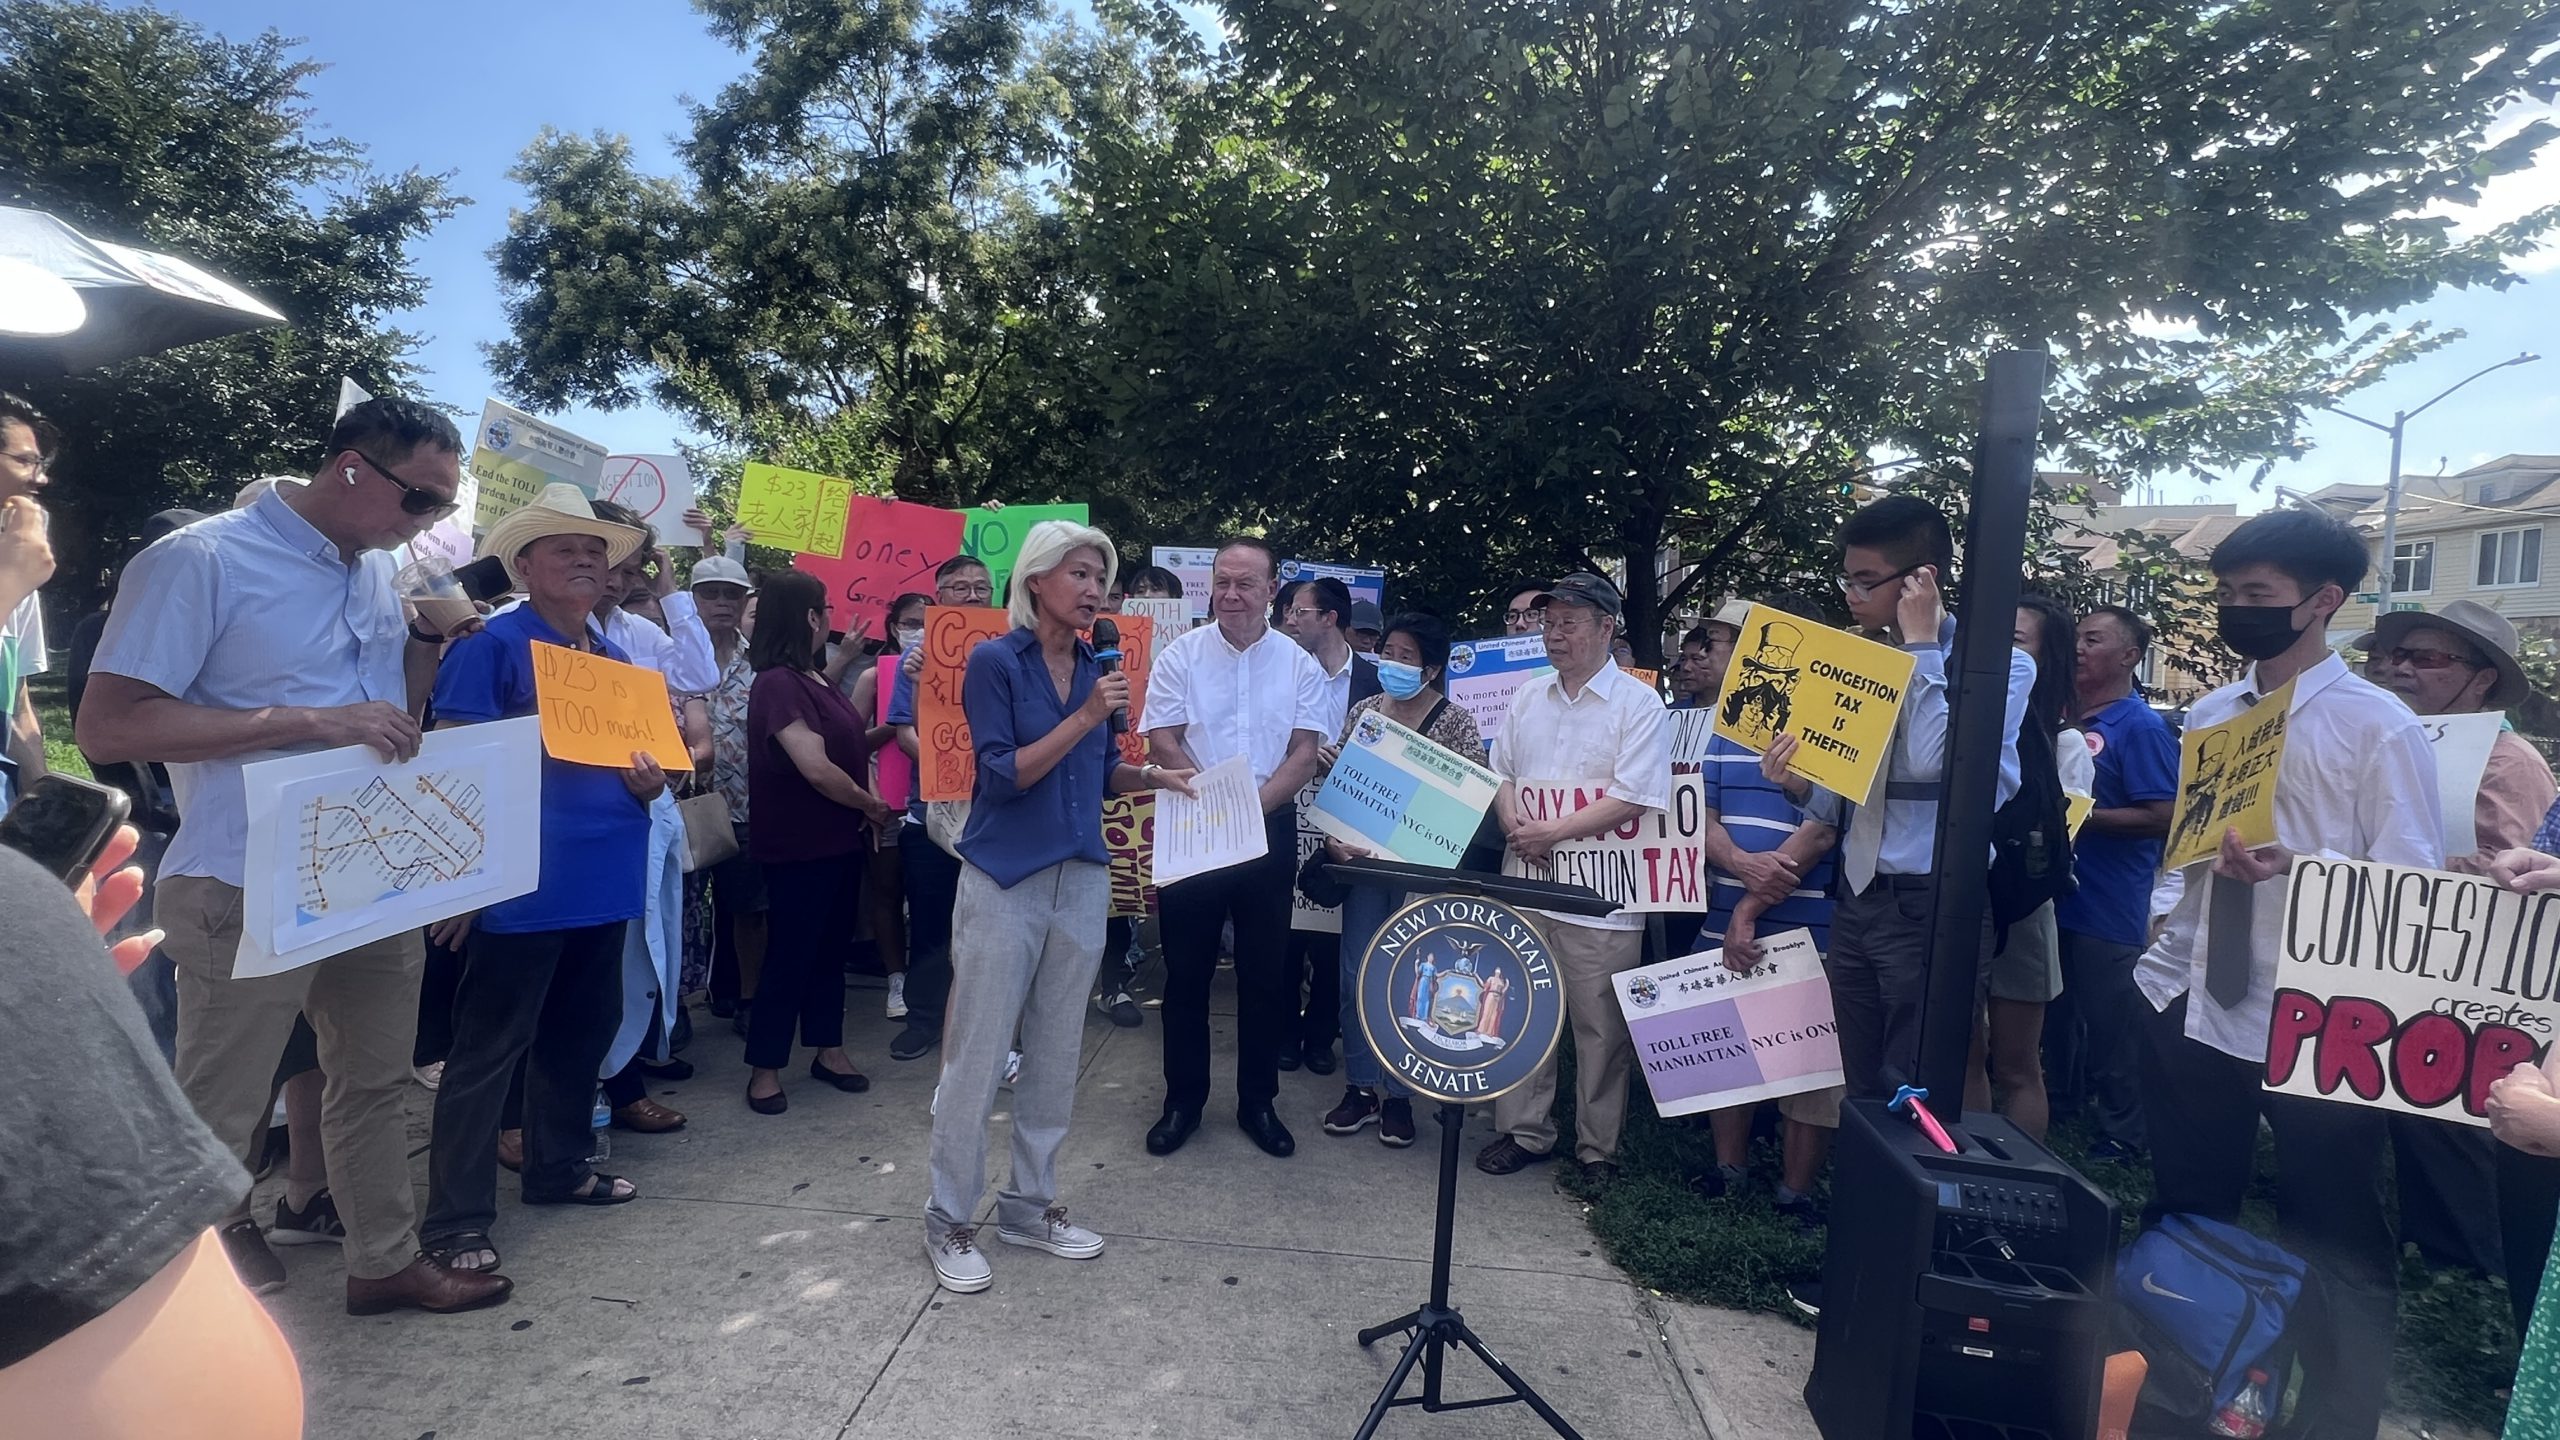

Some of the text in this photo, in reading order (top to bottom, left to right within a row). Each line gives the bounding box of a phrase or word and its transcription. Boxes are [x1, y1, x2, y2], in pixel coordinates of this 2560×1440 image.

[475, 464, 494, 480] End
[496, 471, 510, 486] the
[511, 477, 537, 496] TOLL
[479, 486, 508, 502] urden,
[509, 493, 521, 506] let
[764, 473, 807, 501] $23
[476, 500, 497, 514] ravel
[740, 500, 814, 539] 老人家
[856, 539, 942, 585] oney
[1127, 601, 1182, 621] SOUTH
[538, 644, 597, 692] $23
[1809, 659, 1899, 705] CONGESTION
[1456, 692, 1470, 702] No
[1472, 690, 1498, 700] more
[1834, 692, 1863, 715] TAX
[544, 696, 656, 742] TOO much!
[1481, 716, 1497, 727] all!
[1832, 716, 1846, 732] IS
[1385, 721, 1499, 790] United Chinese Association of Brooklyn
[1801, 726, 1860, 764] THEFT!!!
[1331, 775, 1399, 822] MANHATTAN
[1344, 764, 1371, 788] TOLL
[1371, 781, 1402, 804] FREE
[1521, 786, 1565, 822] SAY
[1399, 814, 1466, 858] NYC is ONE!
[1642, 847, 1699, 903] TAX
[1379, 901, 1553, 991] NEW YORK STATE
[1772, 940, 1806, 954] Brooklyn
[2286, 859, 2560, 1003] CONGESTIO
[1657, 971, 1680, 982] United
[1683, 964, 1709, 975] Chinese
[2431, 996, 2553, 1034] creates
[1647, 1025, 1734, 1055] TOLL FREE
[1648, 1042, 1748, 1075] MANHATTAN
[1750, 1031, 1787, 1051] NYC
[1790, 1029, 1803, 1043] is
[1398, 1052, 1490, 1093] SENATE
